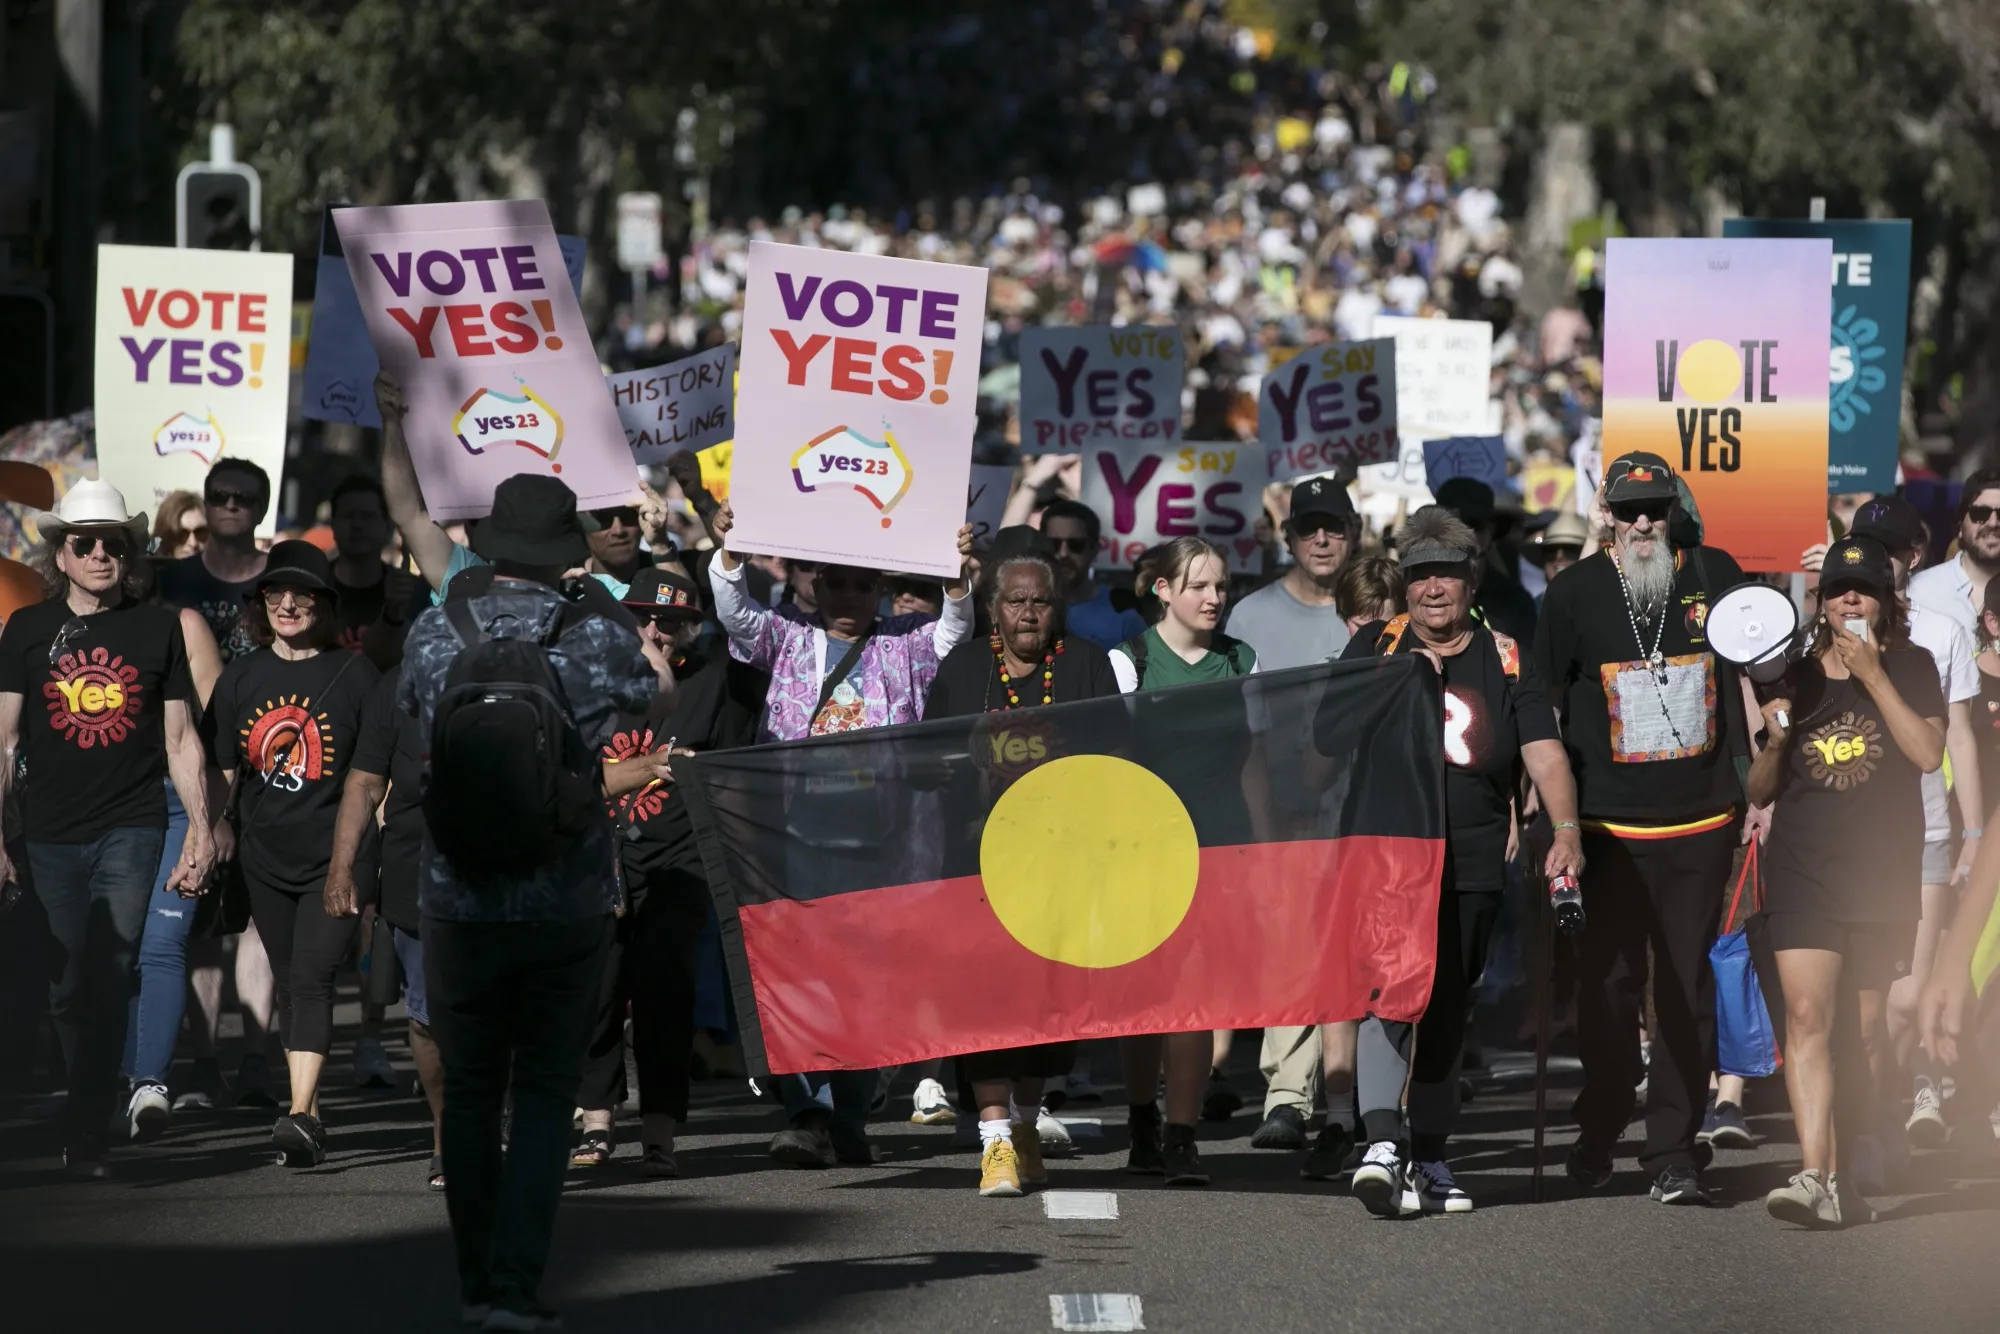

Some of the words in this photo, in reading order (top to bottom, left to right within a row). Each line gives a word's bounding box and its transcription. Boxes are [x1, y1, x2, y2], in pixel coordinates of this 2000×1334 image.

[370, 245, 546, 297] VOTE
[1831, 253, 1872, 286] TE
[121, 286, 268, 333] VOTE
[385, 299, 564, 359] YES!
[774, 271, 960, 340] VOTE
[119, 336, 267, 389] YES!
[613, 355, 727, 407] HISTORY
[769, 327, 955, 405] YES!
[1040, 345, 1156, 419] YES
[473, 413, 540, 435] yes23
[657, 400, 679, 421] IS
[1267, 363, 1383, 443] YES
[818, 452, 889, 476] yes23
[1676, 407, 1742, 473] YES
[1096, 451, 1246, 537] YES
[56, 677, 124, 713] Yes
[989, 728, 1047, 765] Yes
[1813, 735, 1866, 765] Yes
